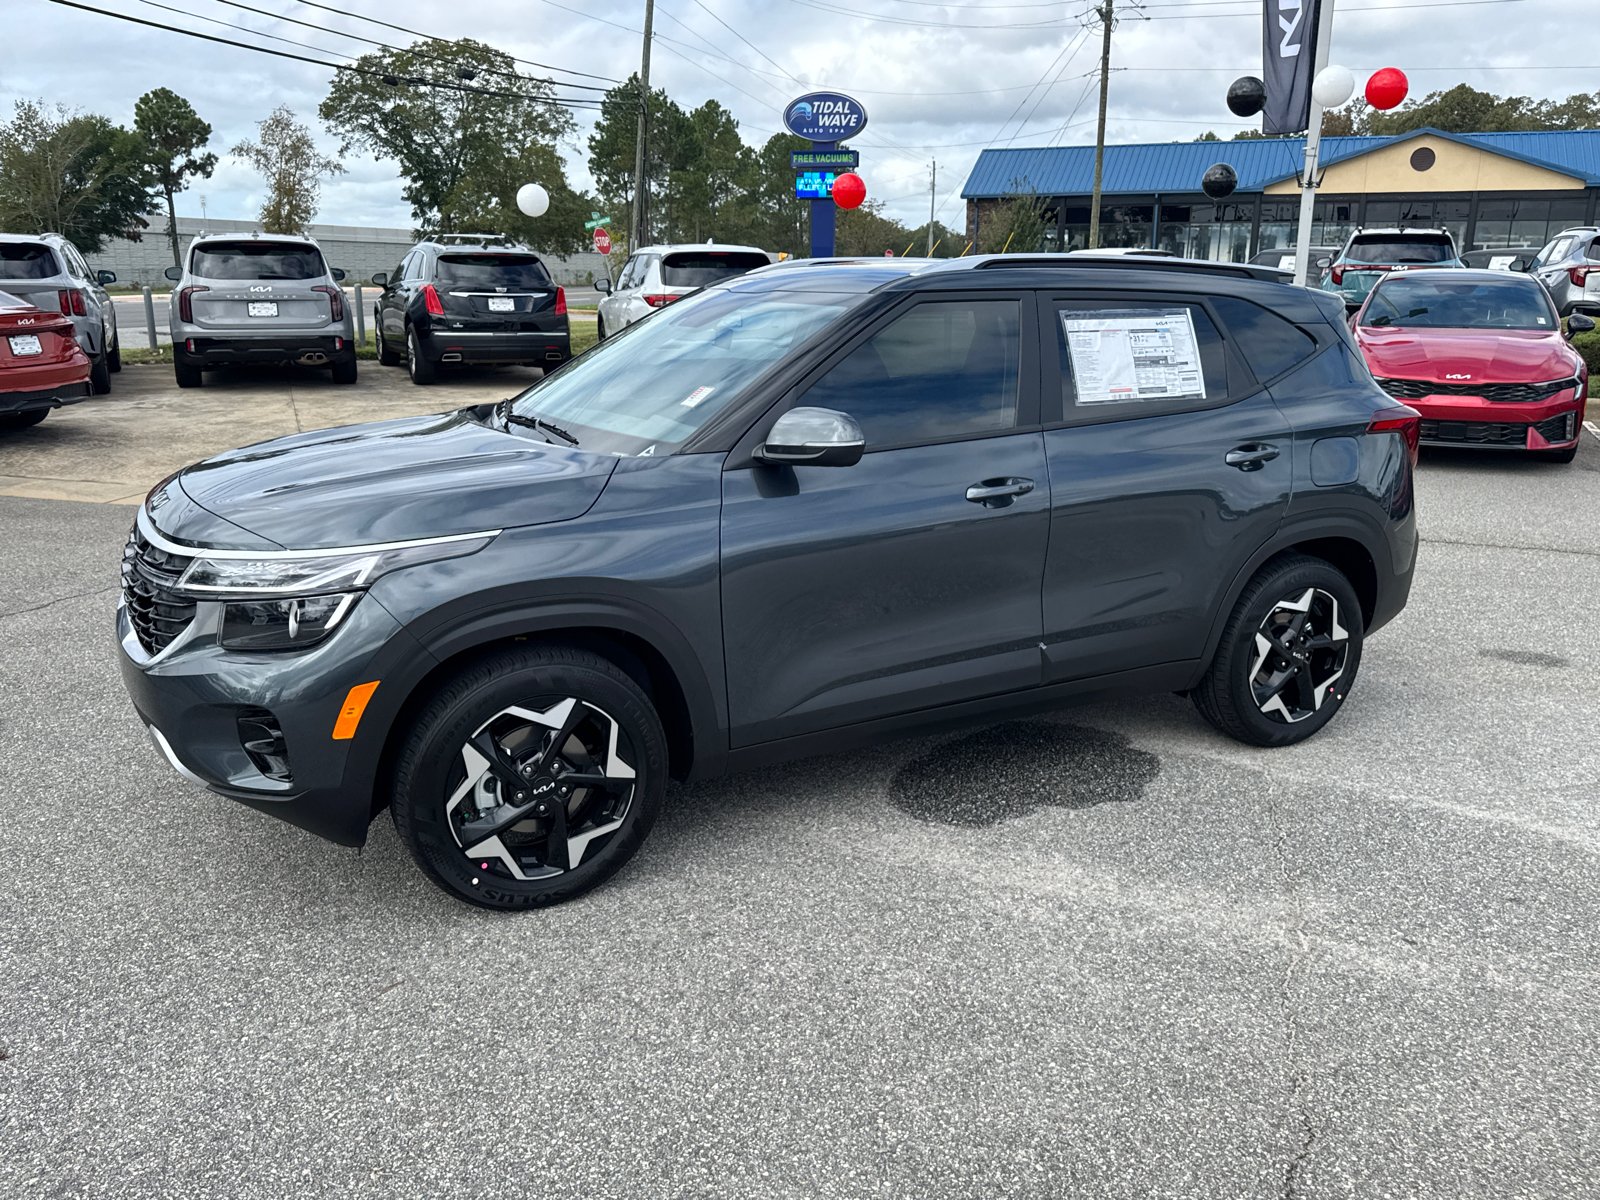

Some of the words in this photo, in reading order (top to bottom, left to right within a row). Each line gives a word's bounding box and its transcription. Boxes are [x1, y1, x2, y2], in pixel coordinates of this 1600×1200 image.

[813, 102, 850, 113] TIDAL
[819, 115, 858, 126] WAVE
[793, 154, 813, 163] FREE
[815, 154, 854, 163] VACUUMS
[595, 236, 610, 247] STOP
[17, 318, 35, 326] KIA
[533, 781, 555, 795] KIA
